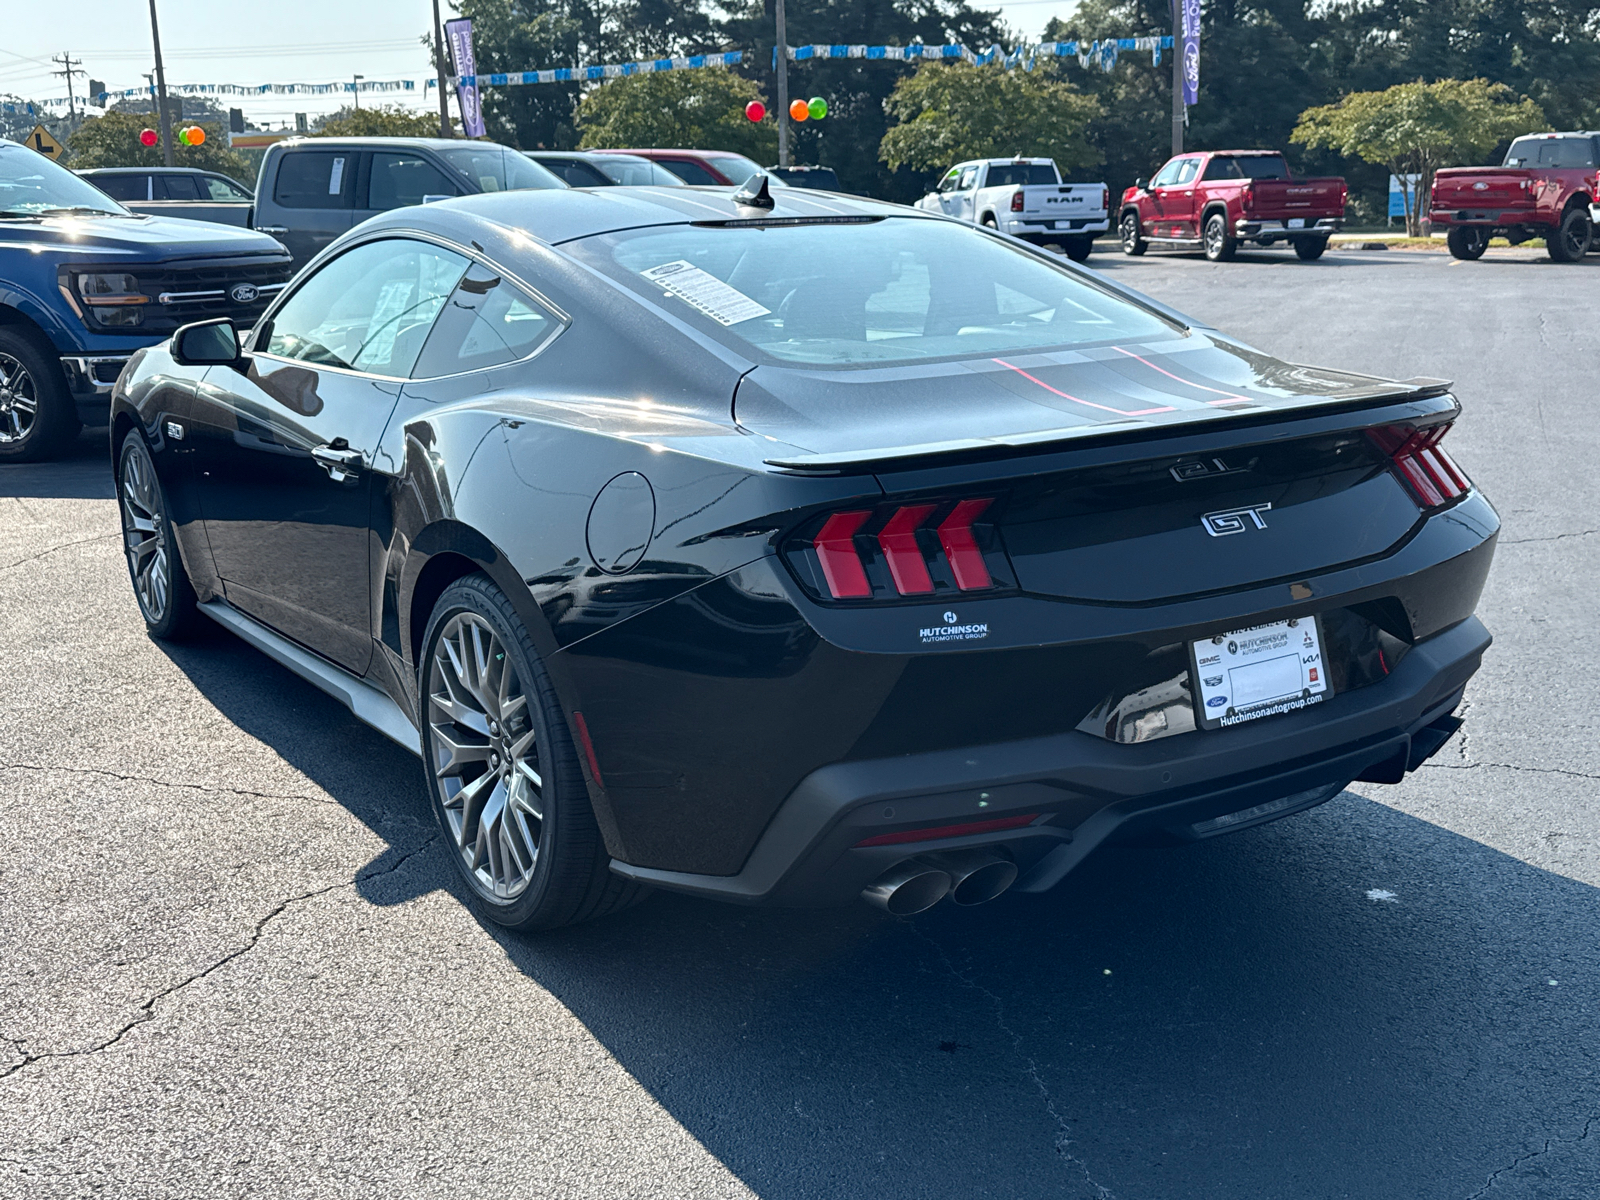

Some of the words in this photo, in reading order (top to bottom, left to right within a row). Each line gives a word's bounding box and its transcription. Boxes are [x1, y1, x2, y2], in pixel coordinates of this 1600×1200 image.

[1185, 52, 1198, 82] Ford
[237, 288, 255, 300] Ford
[1200, 502, 1272, 537] GT
[919, 624, 988, 637] HUTCHINSON
[922, 634, 964, 643] AUTOMOTIVE
[1239, 631, 1289, 650] HUTCHINSON
[1242, 645, 1272, 656] AUTOMOTIVE
[1272, 640, 1288, 649] GROUP
[1199, 655, 1221, 665] GMC
[1210, 697, 1225, 706] Ford
[1220, 694, 1323, 727] Hutchinsonautogroup.com
